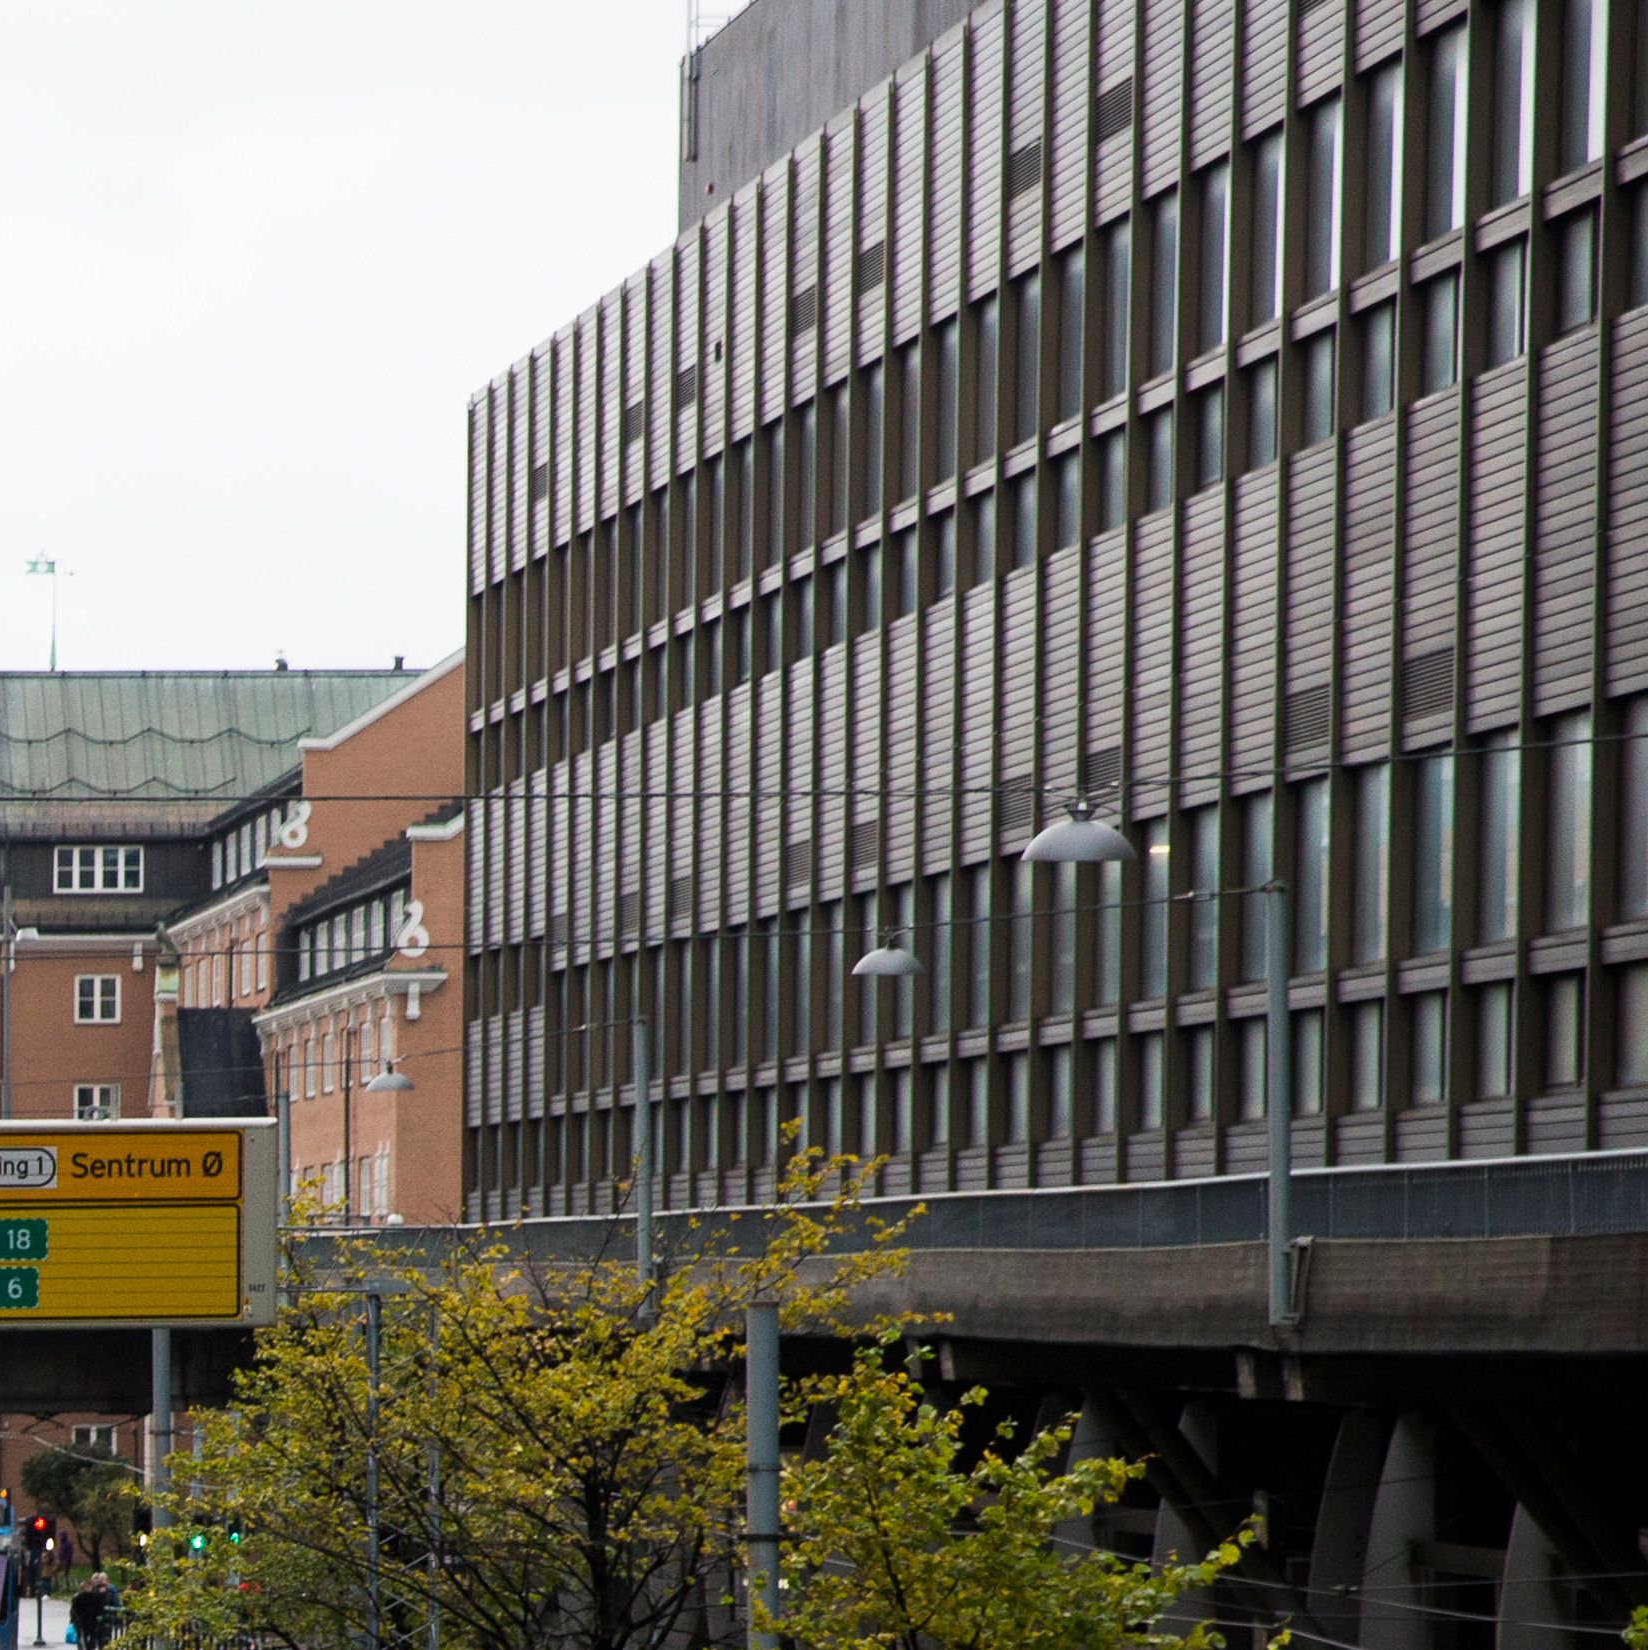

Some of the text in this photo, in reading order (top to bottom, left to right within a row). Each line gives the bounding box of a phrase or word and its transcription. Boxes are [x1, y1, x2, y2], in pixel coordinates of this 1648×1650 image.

[36, 1157, 44, 1175] 1
[71, 1153, 191, 1178] Sentrum
[202, 1151, 223, 1177] Ø
[7, 1229, 31, 1250] 18
[8, 1278, 22, 1299] 6
